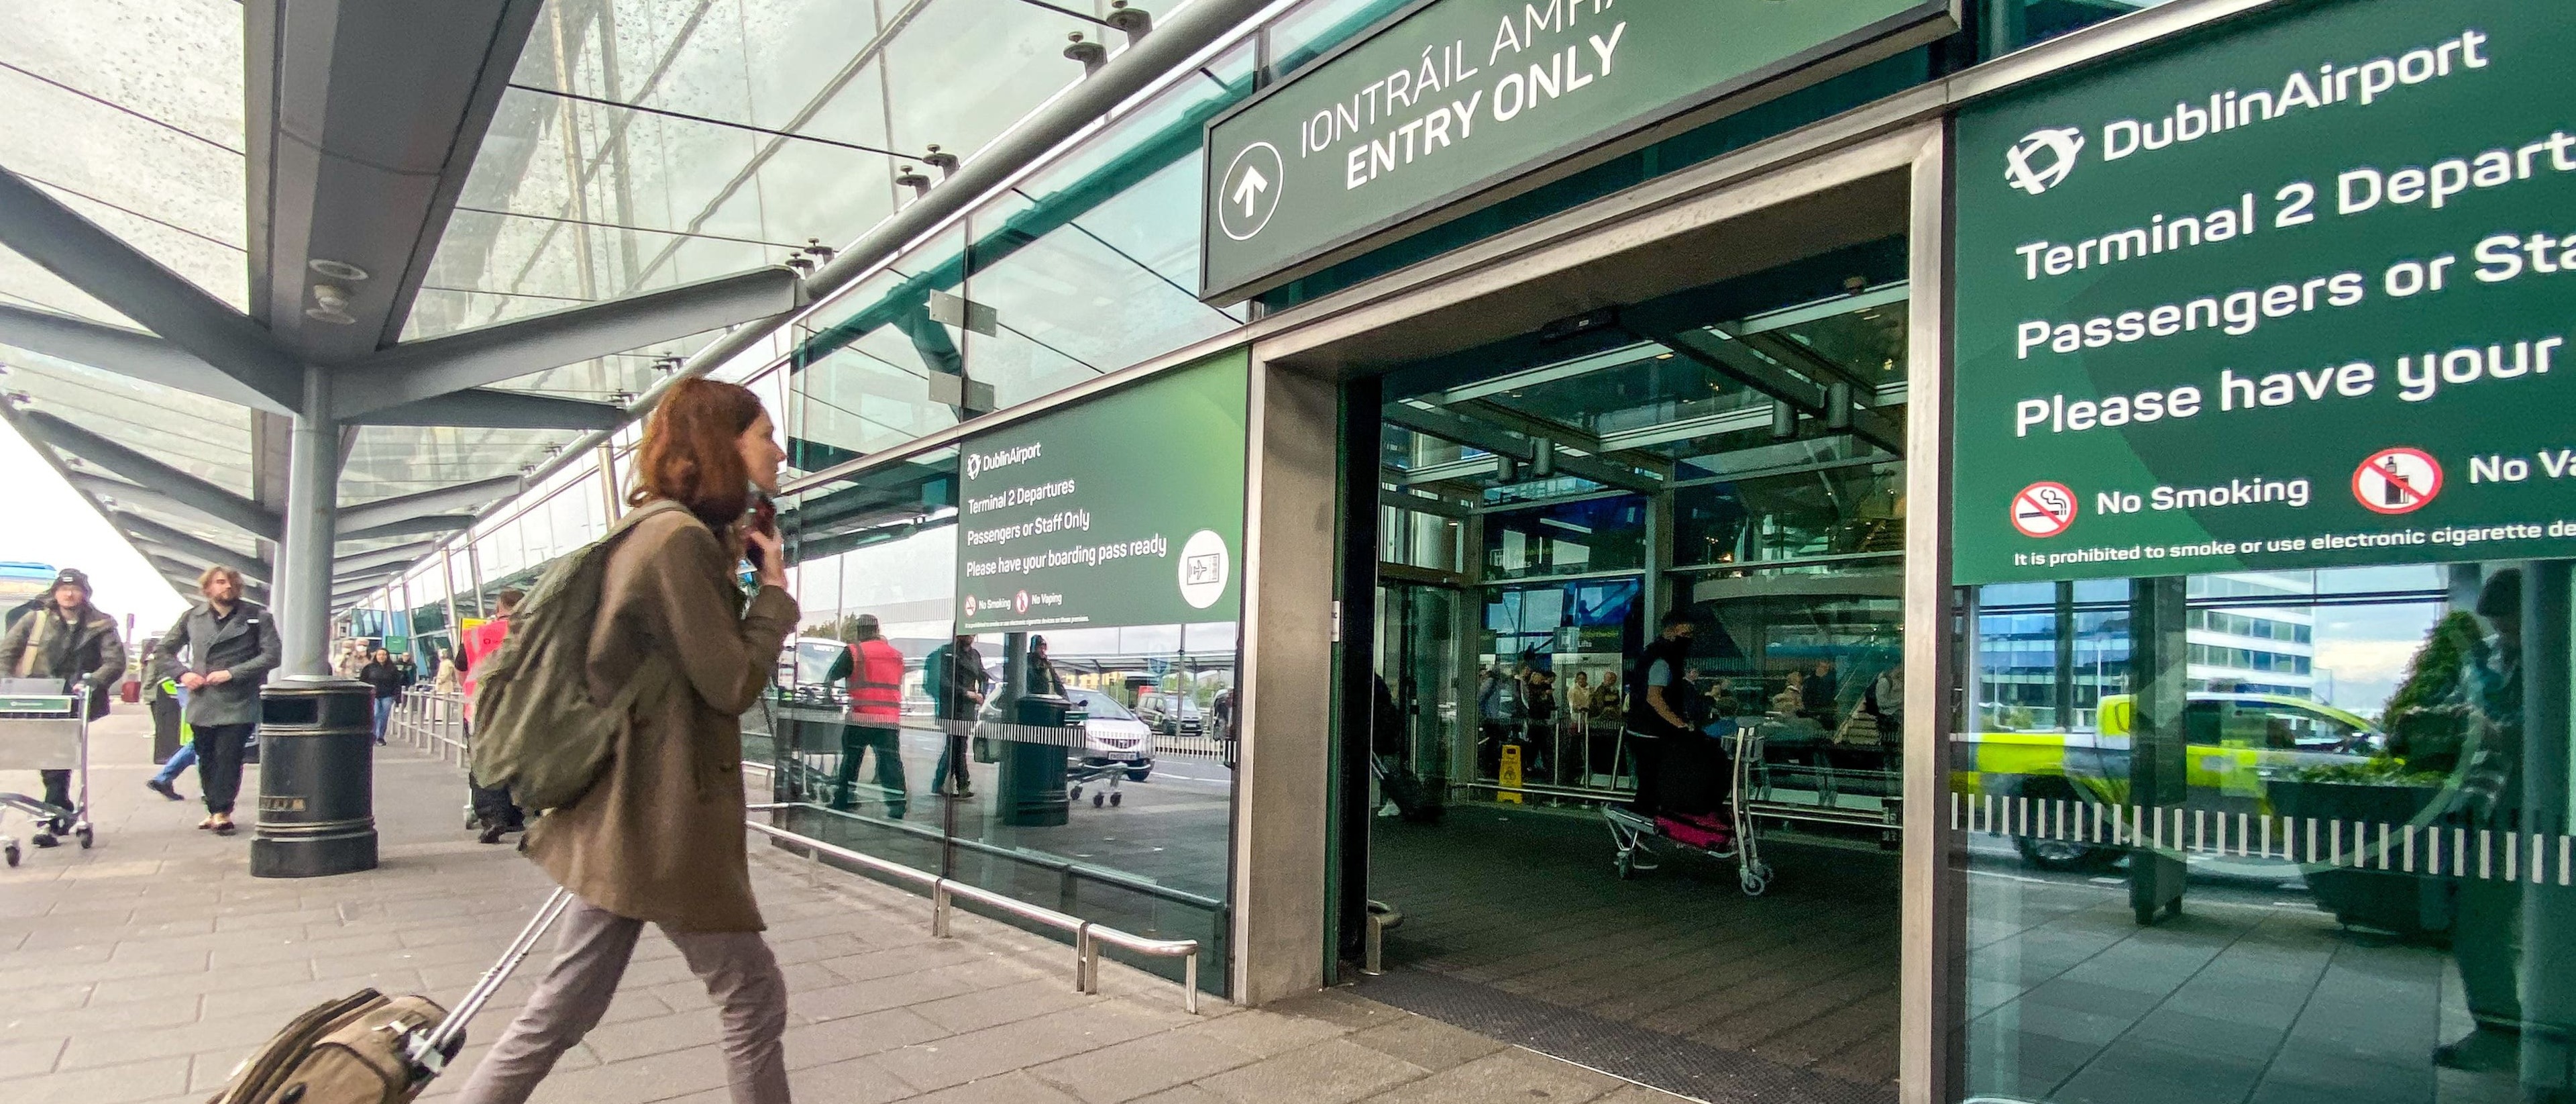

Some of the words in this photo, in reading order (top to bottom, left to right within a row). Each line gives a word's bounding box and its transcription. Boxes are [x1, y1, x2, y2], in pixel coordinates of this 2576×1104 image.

[1303, 40, 1478, 158] IONTRÁIL
[1489, 0, 1613, 66] AM
[2104, 31, 2487, 161] DublinAirport
[1348, 90, 1482, 189] ENTRY
[1494, 21, 1625, 121] ONLY
[2016, 193, 2253, 279] Terminal
[2275, 183, 2314, 228] 2
[2339, 132, 2576, 214] Depart
[2018, 273, 2363, 359] Passengers
[2385, 256, 2455, 296] or
[2017, 387, 2200, 437] Please
[2222, 363, 2374, 411] have
[2398, 338, 2562, 401] your
[983, 442, 1041, 471] DublinAirport
[2471, 456, 2528, 483] No
[968, 491, 1006, 514] Terminal
[1008, 489, 1015, 506] 2
[1017, 479, 1075, 505] Departures
[2098, 491, 2141, 514] No
[2151, 478, 2308, 510] Smoking
[968, 525, 1020, 546] Passengers
[1022, 523, 1034, 536] or
[1034, 513, 1062, 535] Staff
[1064, 509, 1090, 531] Only
[2015, 554, 2027, 566] It
[2031, 552, 2045, 564] is
[2050, 546, 2140, 567] prohibited
[2144, 547, 2165, 558] to
[2169, 541, 2236, 557] smoke
[2241, 542, 2262, 553] or
[2267, 540, 2306, 552] use
[2312, 530, 2425, 549] electronic
[2431, 525, 2542, 546] cigarette
[967, 560, 996, 576] Please
[998, 557, 1021, 573] have
[1023, 555, 1046, 574] your
[1049, 546, 1095, 567] boarding
[1098, 542, 1126, 564] pass
[1130, 534, 1167, 557] ready
[979, 600, 986, 609] No
[987, 598, 1011, 610] Smoking
[1032, 594, 1040, 605] No
[1041, 593, 1062, 606] Vaping
